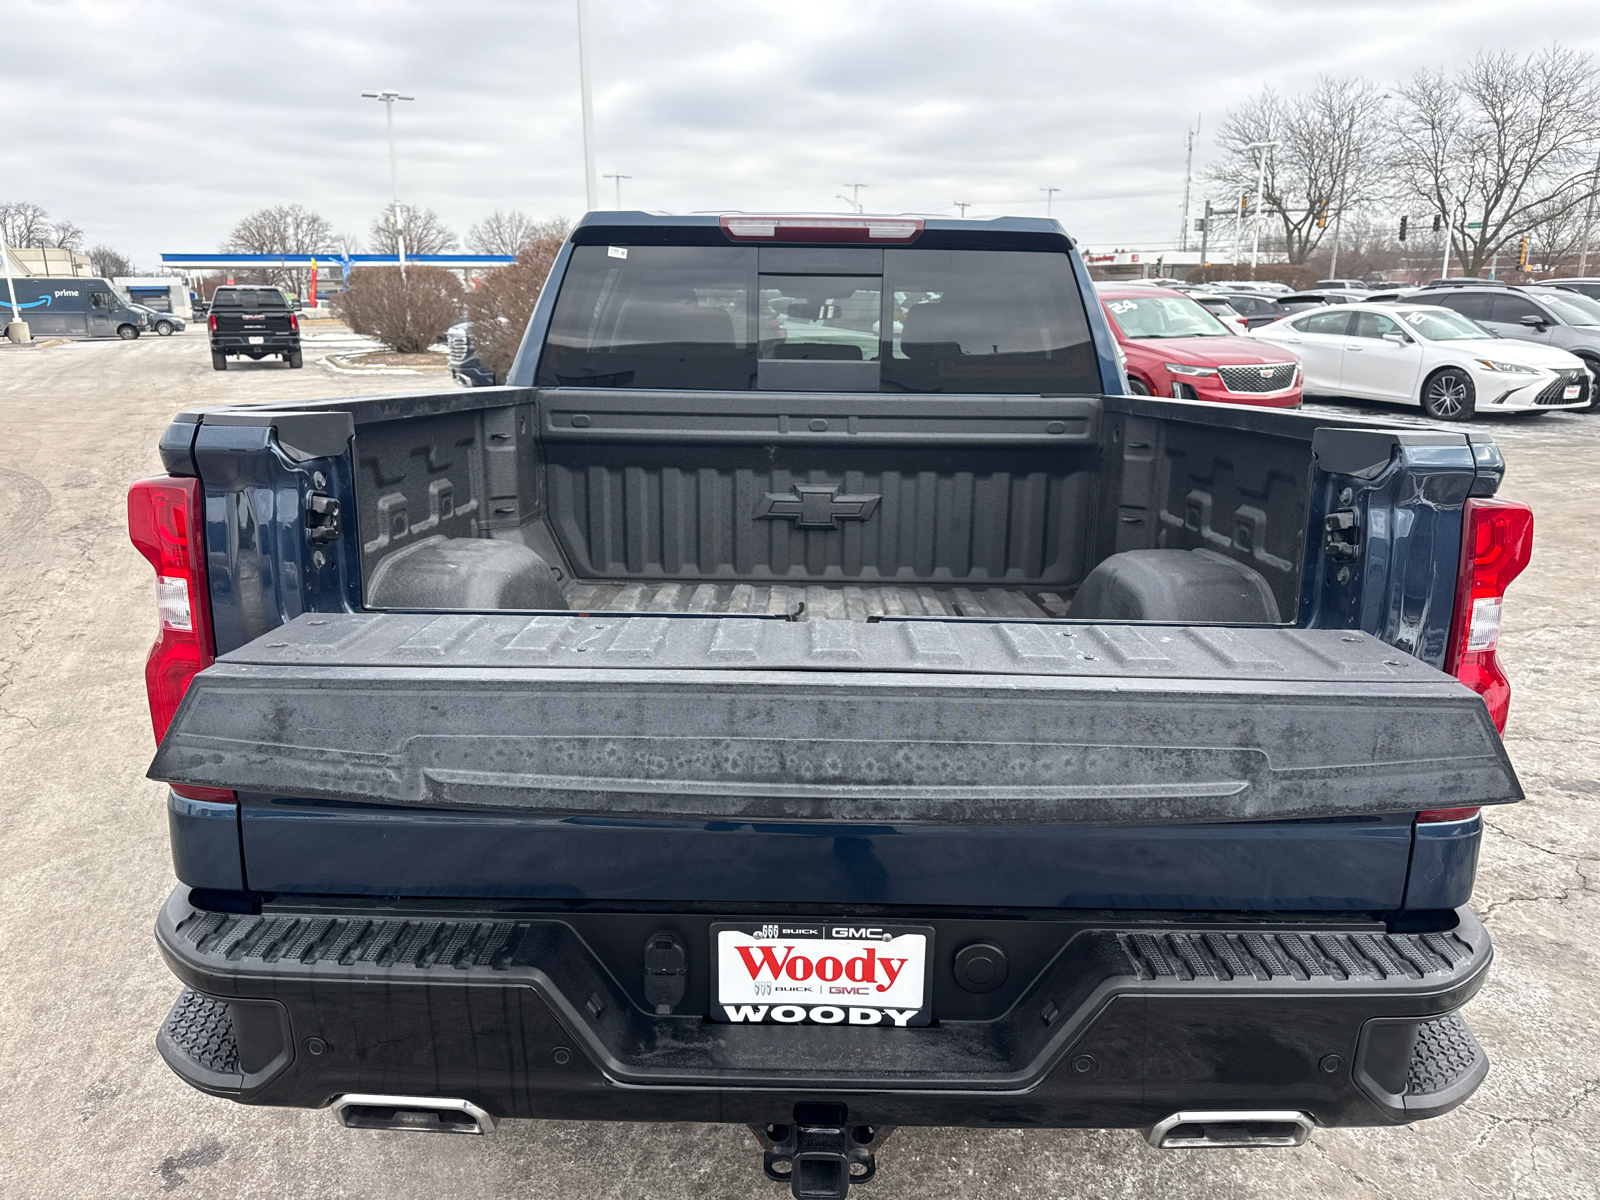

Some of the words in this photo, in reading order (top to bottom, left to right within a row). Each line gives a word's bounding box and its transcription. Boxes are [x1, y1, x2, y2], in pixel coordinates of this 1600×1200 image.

[54, 289, 79, 298] prime
[1107, 299, 1138, 315] 24
[831, 927, 883, 939] GMC
[734, 946, 909, 993] Woody
[828, 986, 870, 995] GMC
[723, 1005, 919, 1027] WOODY
